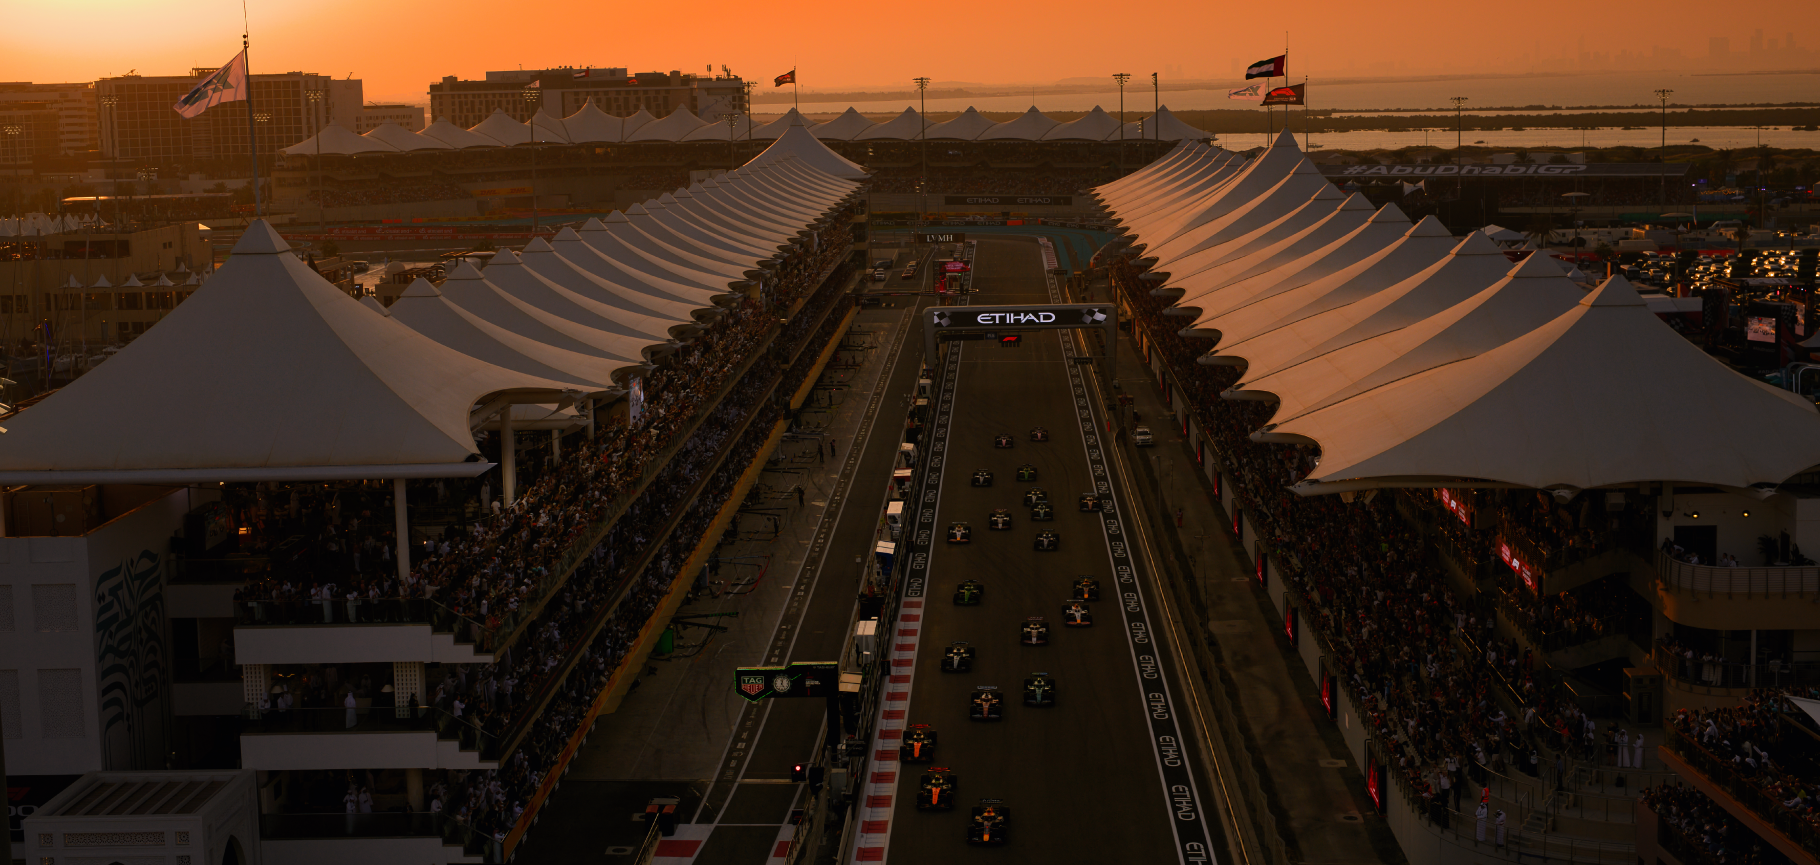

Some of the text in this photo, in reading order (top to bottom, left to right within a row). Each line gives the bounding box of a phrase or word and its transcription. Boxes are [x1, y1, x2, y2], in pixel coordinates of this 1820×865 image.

[1342, 164, 1588, 175] #AbuDhabiGP
[926, 234, 953, 242] LVMH
[977, 312, 1056, 324] ETIHAD
[1118, 566, 1132, 584] ETIHAD
[908, 578, 922, 596] ETIHAD
[1124, 592, 1140, 612] ETIHAD
[1132, 622, 1148, 644] ETIHAD
[1140, 654, 1158, 680] ETIHAD
[742, 684, 762, 693] HEUER
[1148, 692, 1168, 720] ETIHAD
[1159, 735, 1181, 767] ETIHAD
[1172, 784, 1196, 821] ETIHAD
